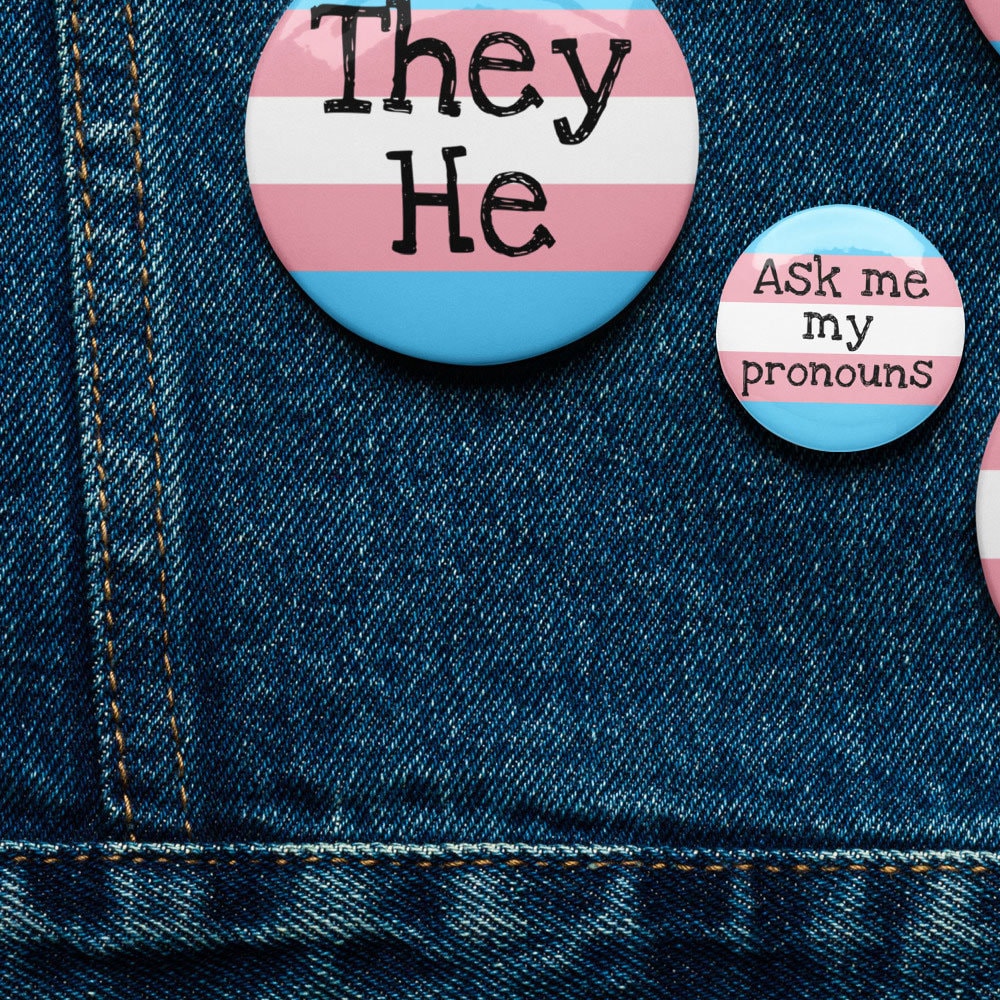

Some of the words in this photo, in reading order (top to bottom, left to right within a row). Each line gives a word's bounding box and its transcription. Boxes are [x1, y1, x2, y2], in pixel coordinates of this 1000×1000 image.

[385, 145, 556, 258] He
[753, 254, 842, 298] Ask
[860, 268, 930, 299] me
[802, 311, 874, 352] my
[741, 360, 933, 397] pronouns
